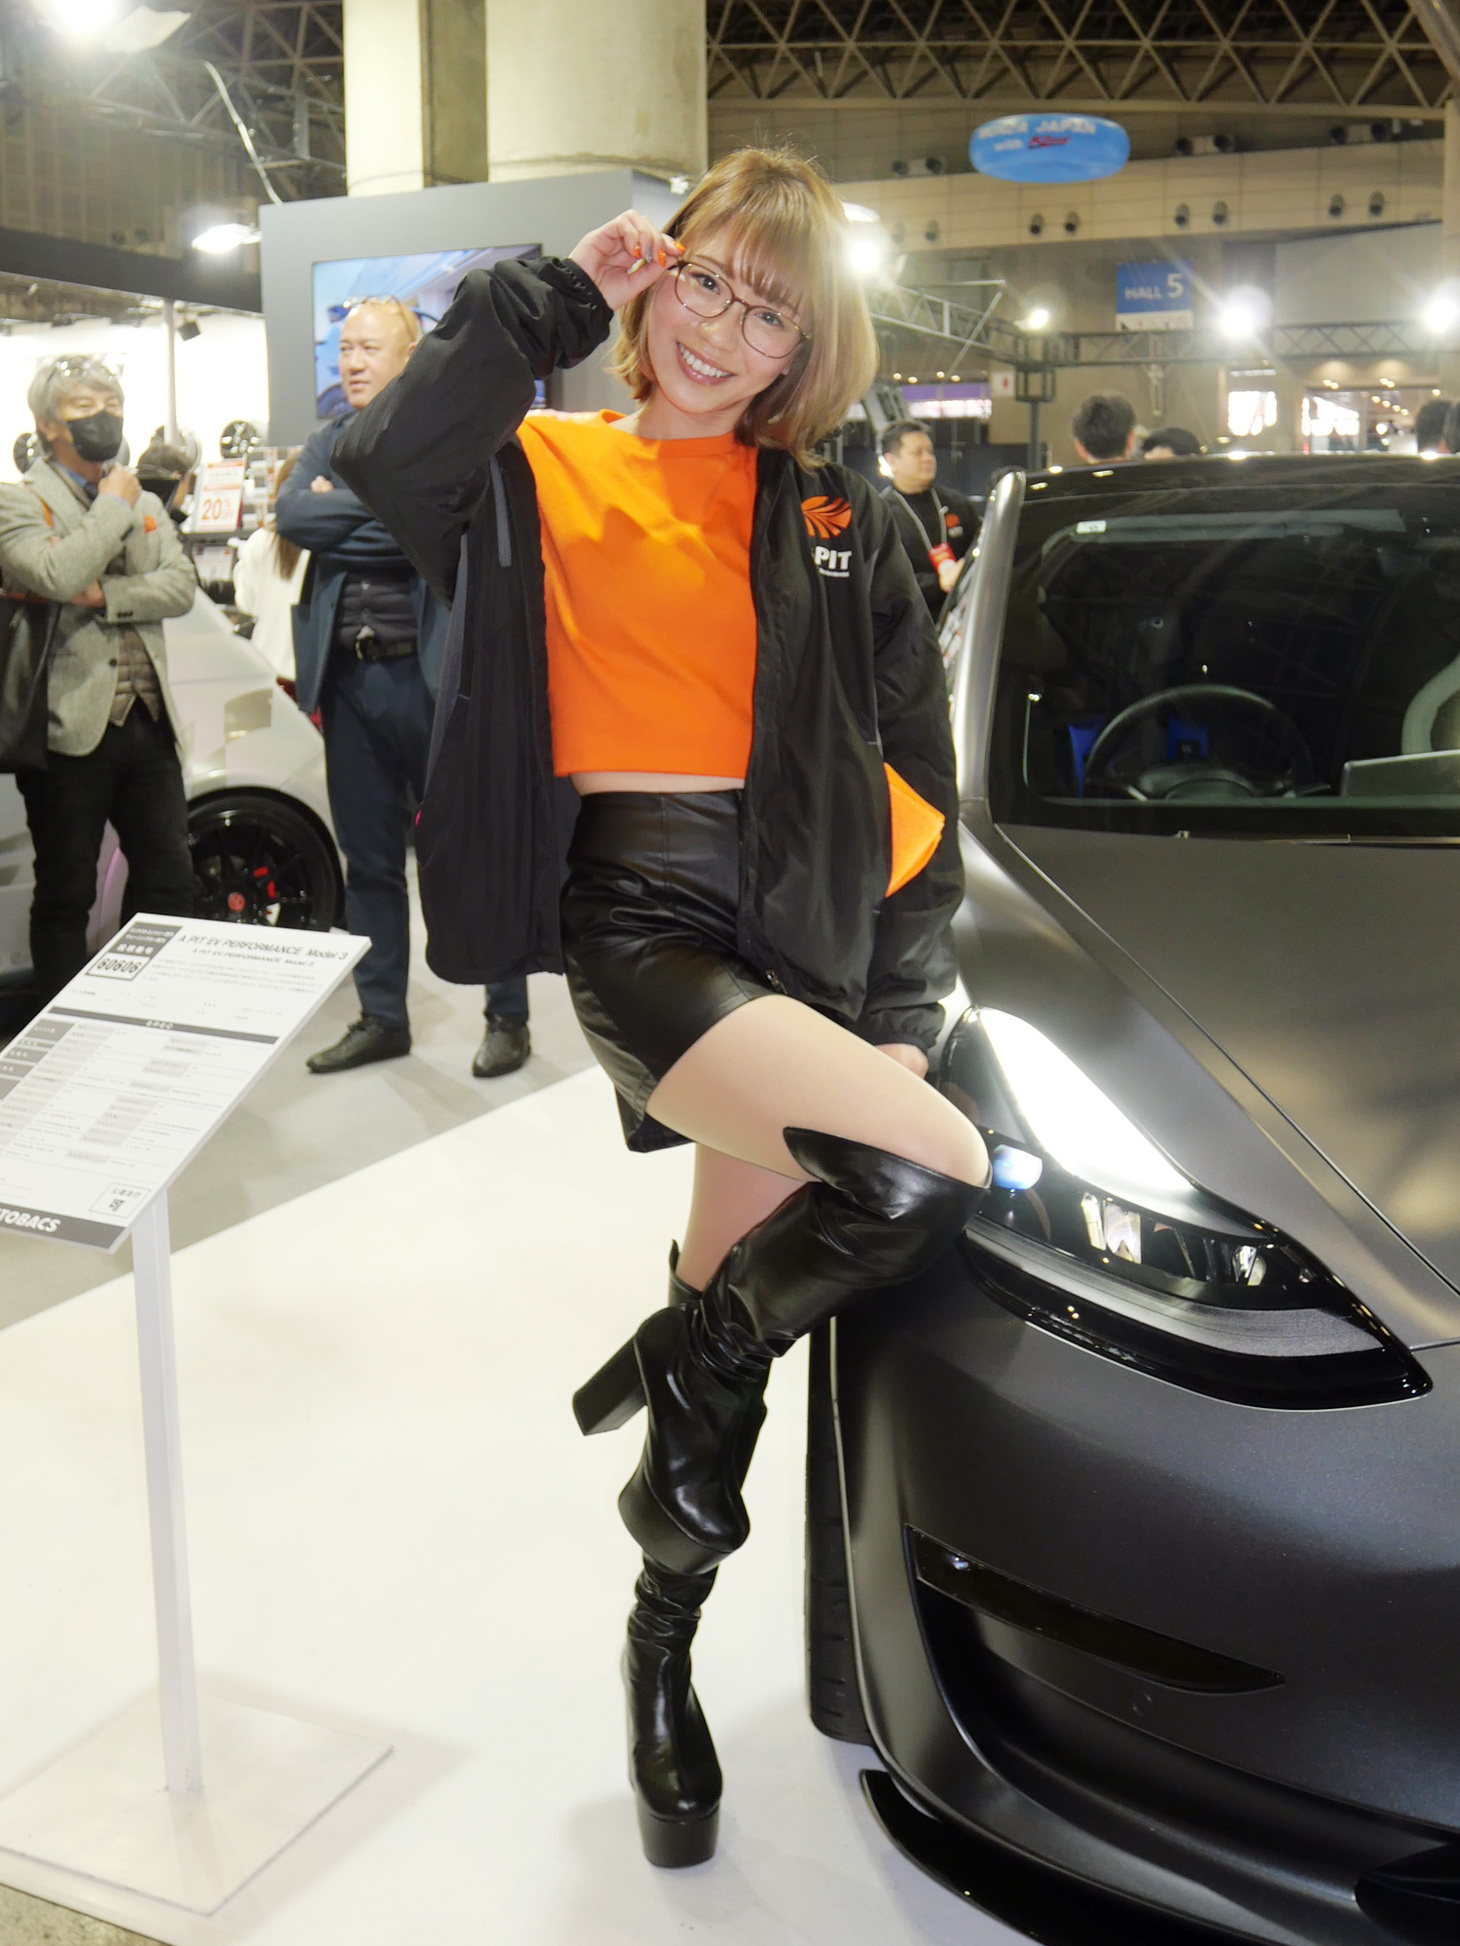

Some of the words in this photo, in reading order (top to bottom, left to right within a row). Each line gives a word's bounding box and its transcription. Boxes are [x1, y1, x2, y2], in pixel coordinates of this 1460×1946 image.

[1124, 286, 1162, 299] HALL
[1167, 273, 1184, 298] 5
[814, 545, 852, 570] PIT
[187, 935, 205, 943] PIT
[206, 937, 221, 946] EV
[221, 939, 304, 955] PERFORMANCE
[305, 949, 338, 960] Model
[339, 952, 349, 960] 3
[97, 958, 142, 973] 60606
[0, 1207, 61, 1232] TOBACS
